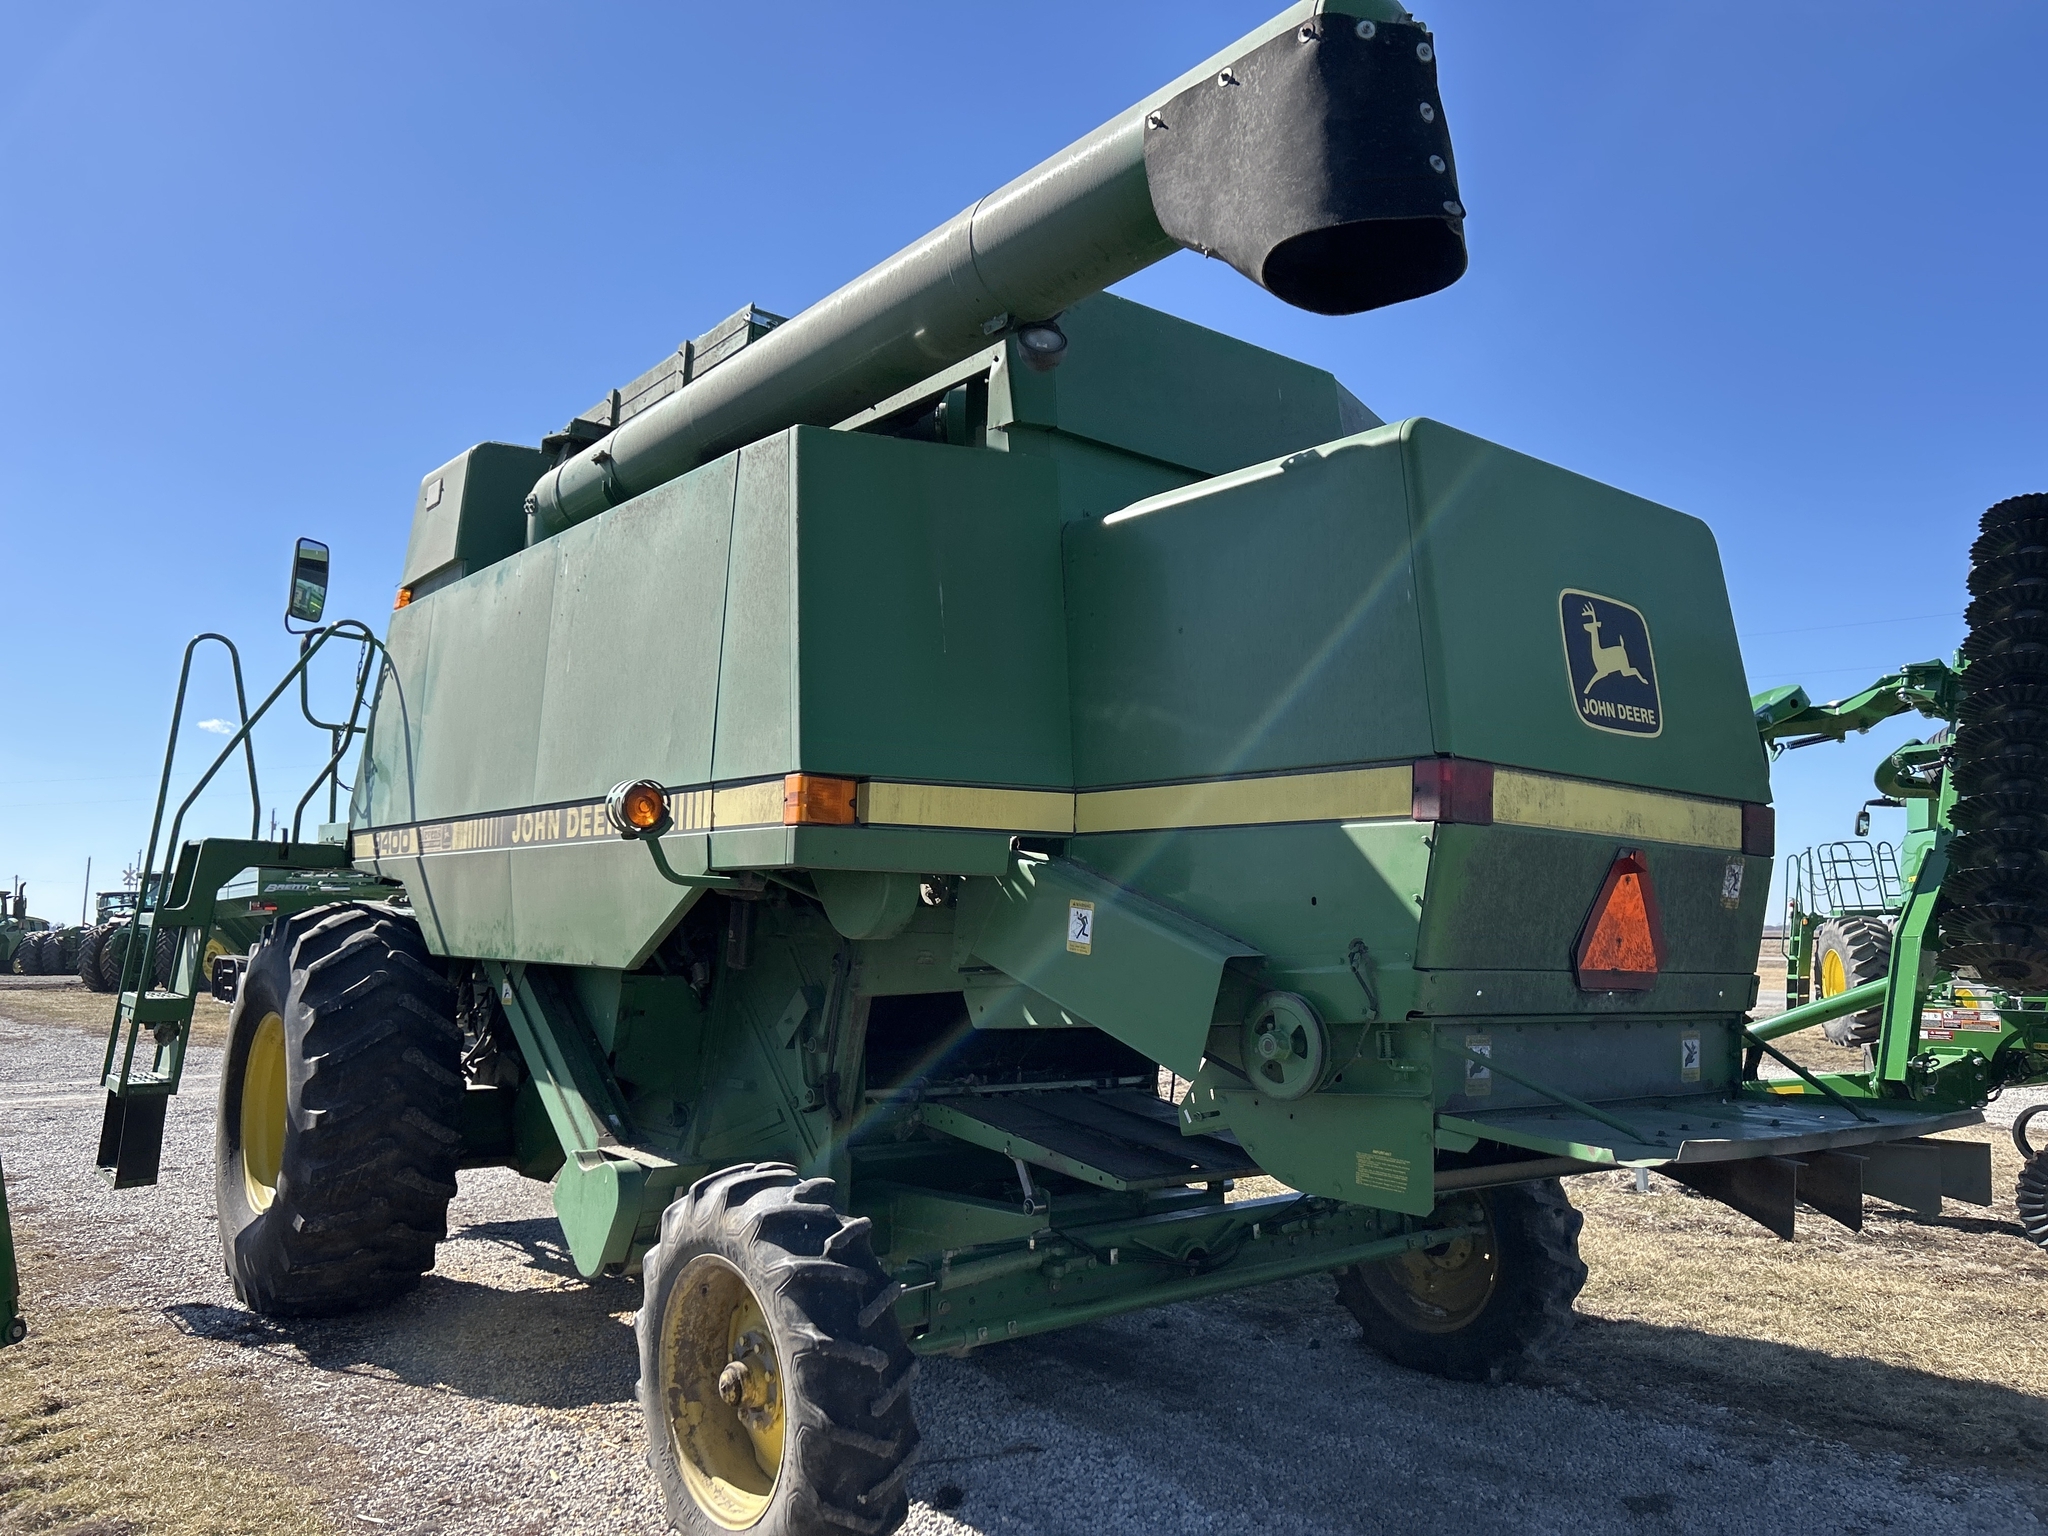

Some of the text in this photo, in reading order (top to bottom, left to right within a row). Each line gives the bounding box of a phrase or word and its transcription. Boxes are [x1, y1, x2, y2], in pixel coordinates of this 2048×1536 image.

[1583, 698, 1657, 725] JOHN DEERE
[511, 809, 560, 844] JOHN
[264, 883, 309, 892] BRENT
